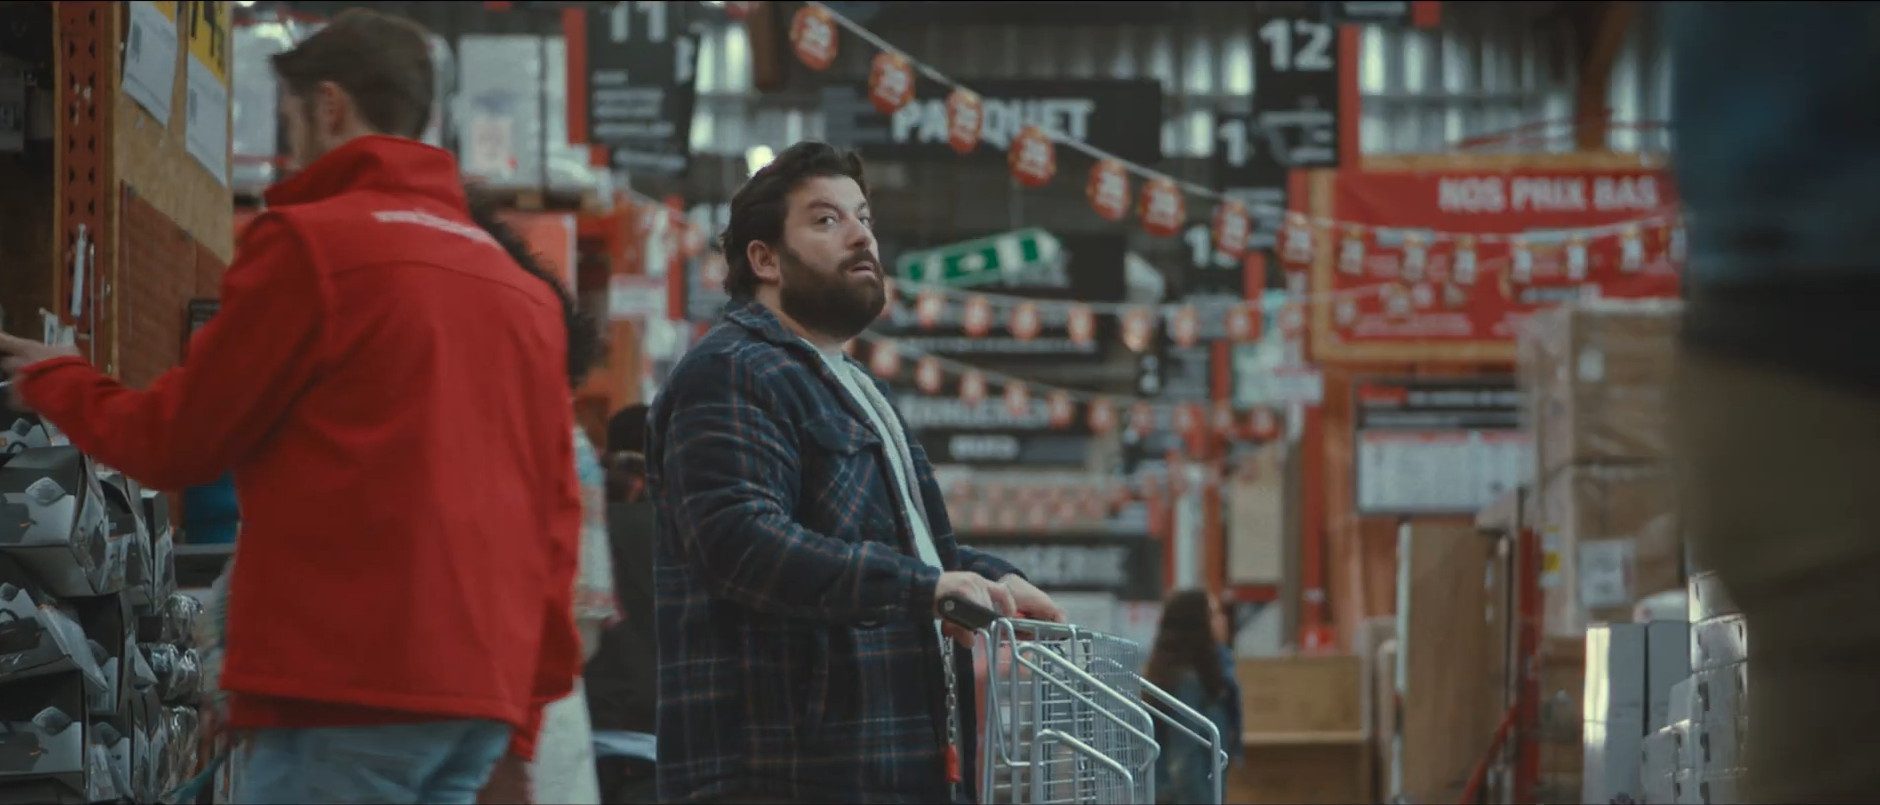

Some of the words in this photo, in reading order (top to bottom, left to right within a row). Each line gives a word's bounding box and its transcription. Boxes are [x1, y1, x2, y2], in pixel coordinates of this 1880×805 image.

[1259, 19, 1334, 71] 12
[892, 99, 1094, 147] PAQUET
[1437, 177, 1505, 212] NOS
[1593, 176, 1658, 210] BAS
